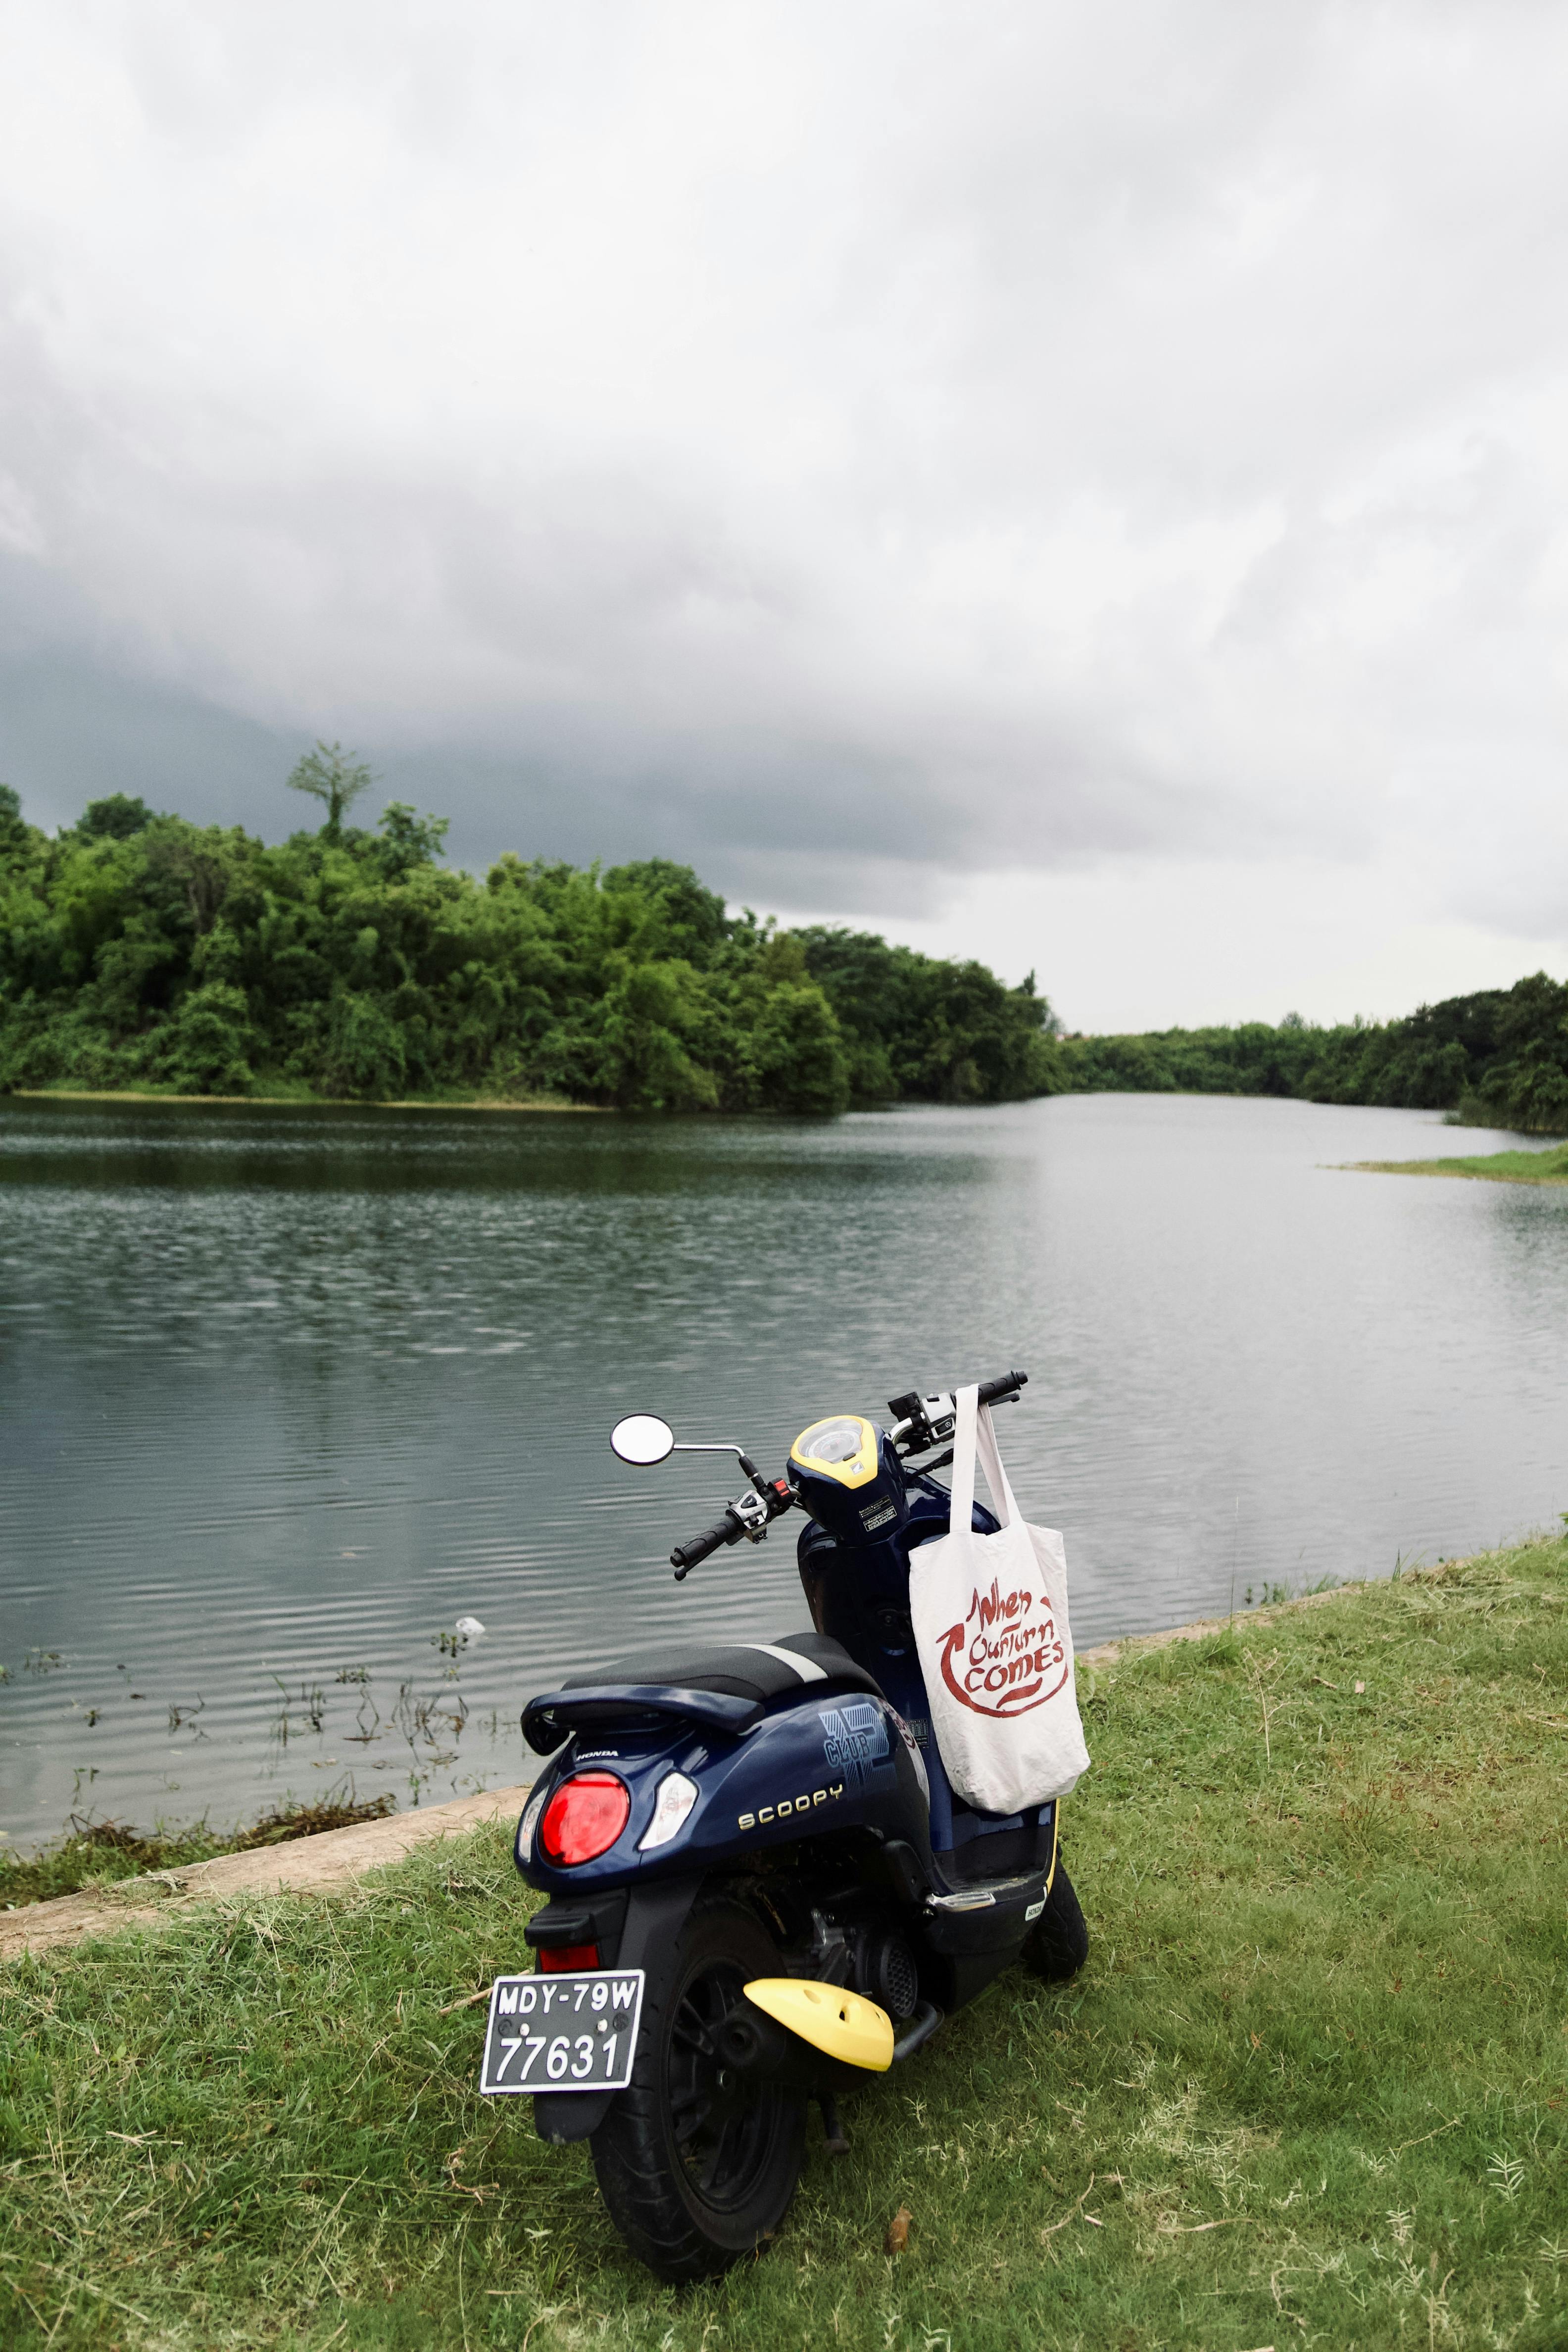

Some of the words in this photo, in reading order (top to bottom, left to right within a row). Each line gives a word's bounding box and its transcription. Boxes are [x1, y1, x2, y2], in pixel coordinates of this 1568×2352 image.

[966, 1576, 1031, 1631] When
[576, 1750, 618, 1761] HONDA
[824, 1731, 873, 1768] CLUB
[738, 1784, 843, 1830] SCOOPY
[498, 1981, 637, 2014] MDY-79W
[495, 2033, 618, 2082] 77631
